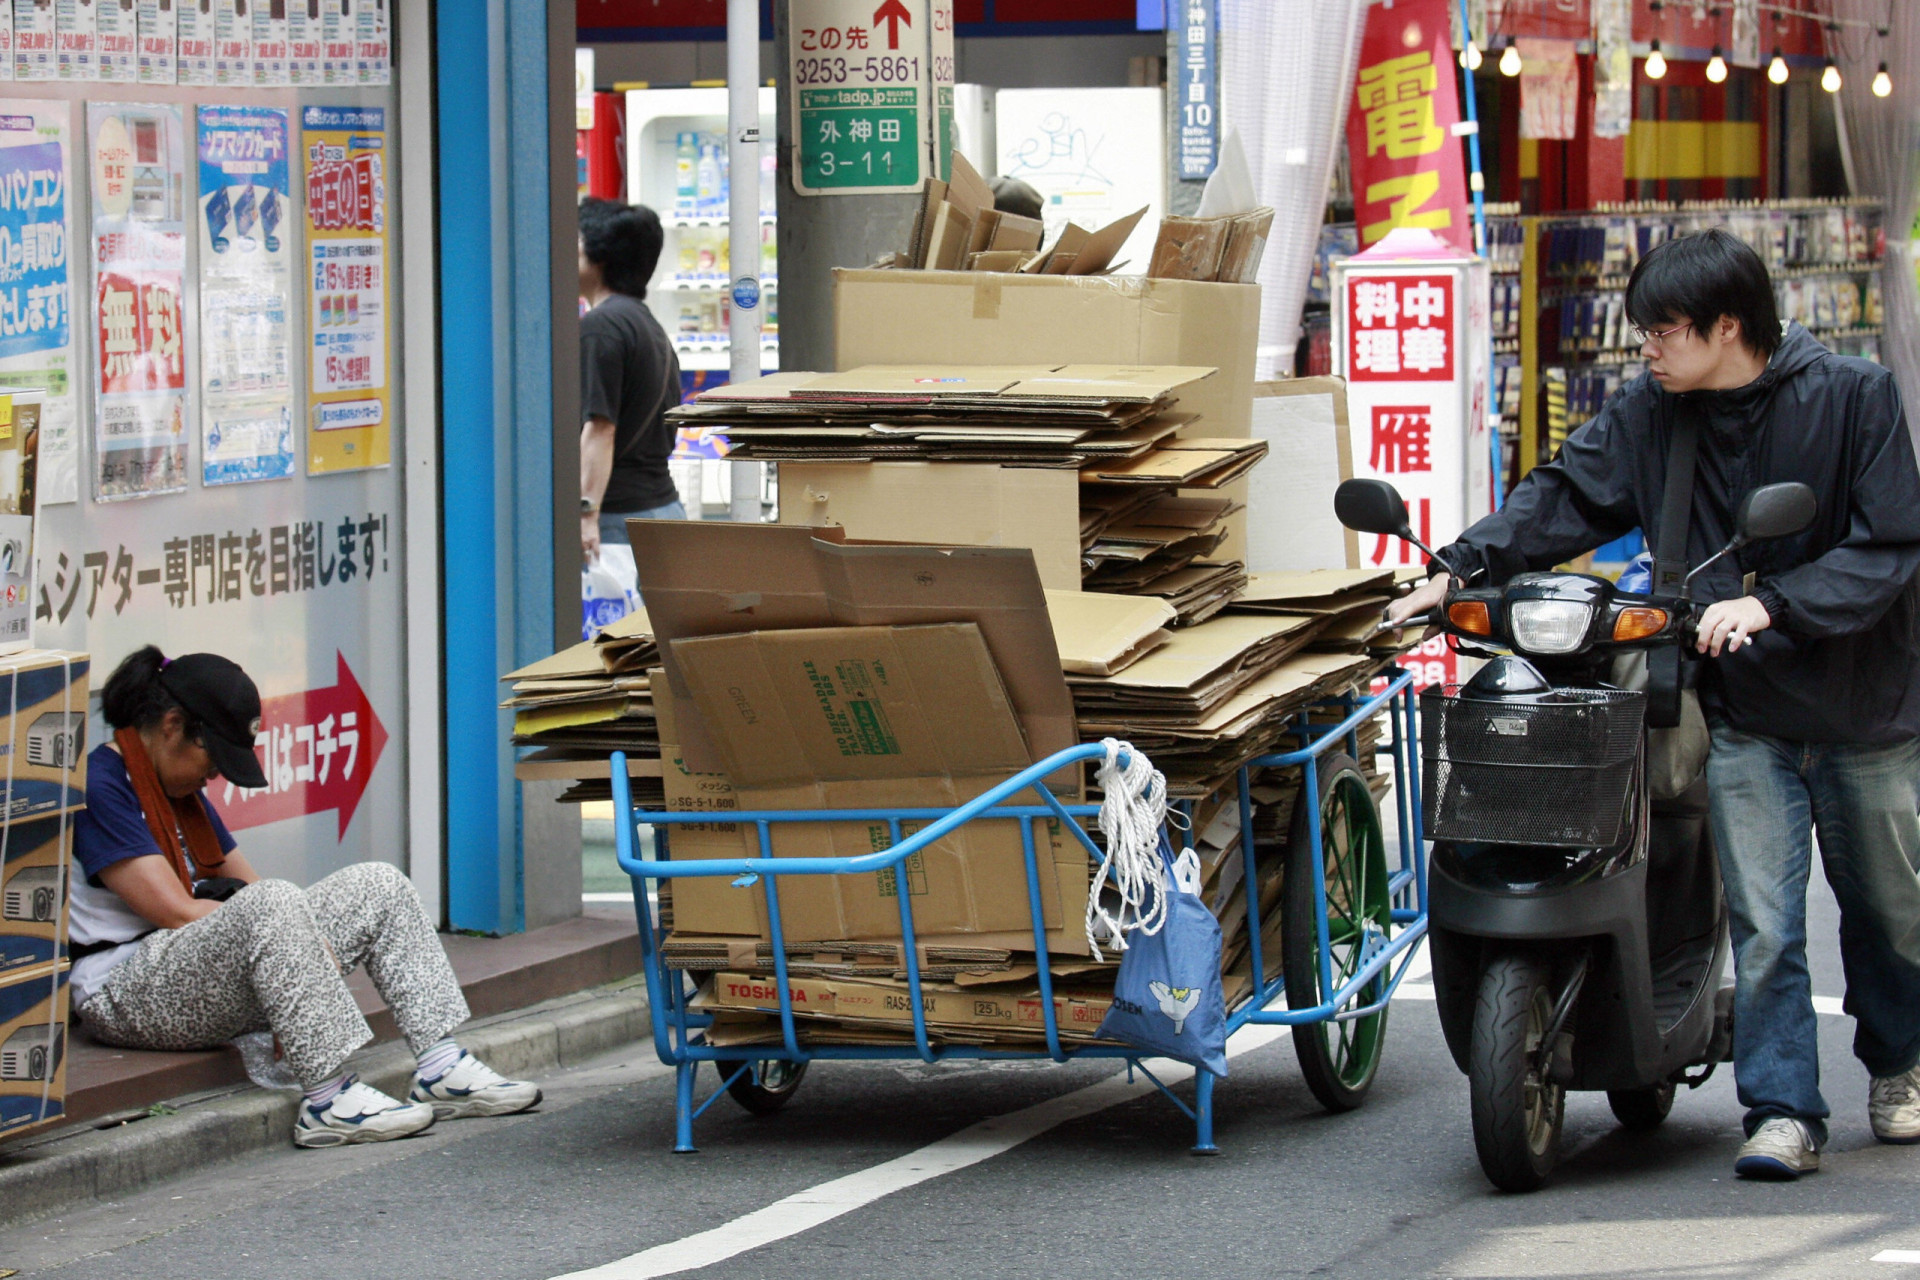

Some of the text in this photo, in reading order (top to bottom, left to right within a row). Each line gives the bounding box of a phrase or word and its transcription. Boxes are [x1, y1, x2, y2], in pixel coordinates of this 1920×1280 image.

[801, 26, 868, 50] この先
[796, 56, 918, 84] 3253-5861
[1183, 104, 1212, 126] 10
[819, 118, 900, 143] 外神田
[820, 151, 891, 175] 3-11
[727, 984, 808, 1003] TOSHBA
